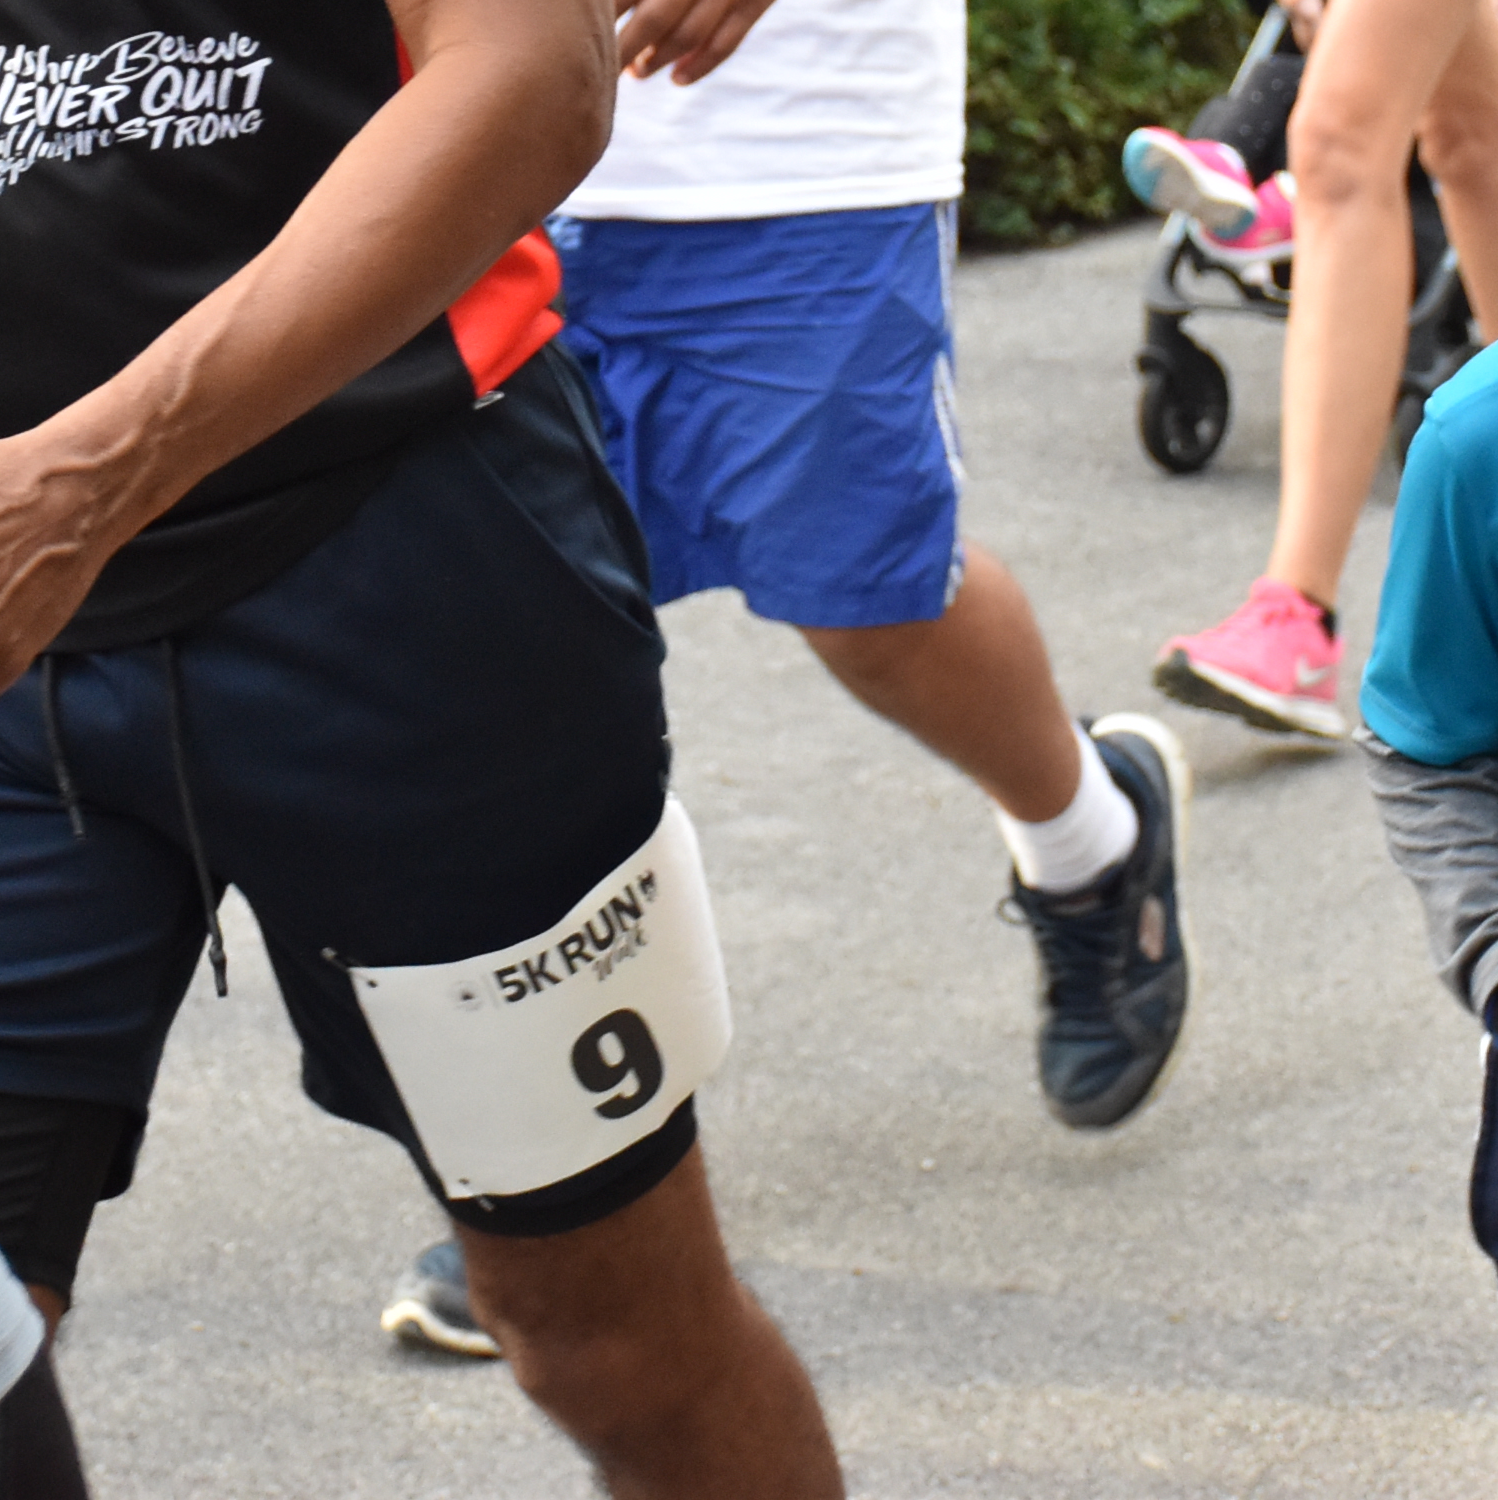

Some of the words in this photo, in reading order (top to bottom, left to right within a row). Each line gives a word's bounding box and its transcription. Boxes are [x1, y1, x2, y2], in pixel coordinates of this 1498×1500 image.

[115, 108, 265, 151] STRONG
[140, 57, 273, 117] QUIT
[494, 950, 562, 1004] 5K
[557, 884, 646, 977] RUN
[570, 1007, 665, 1120] 9
